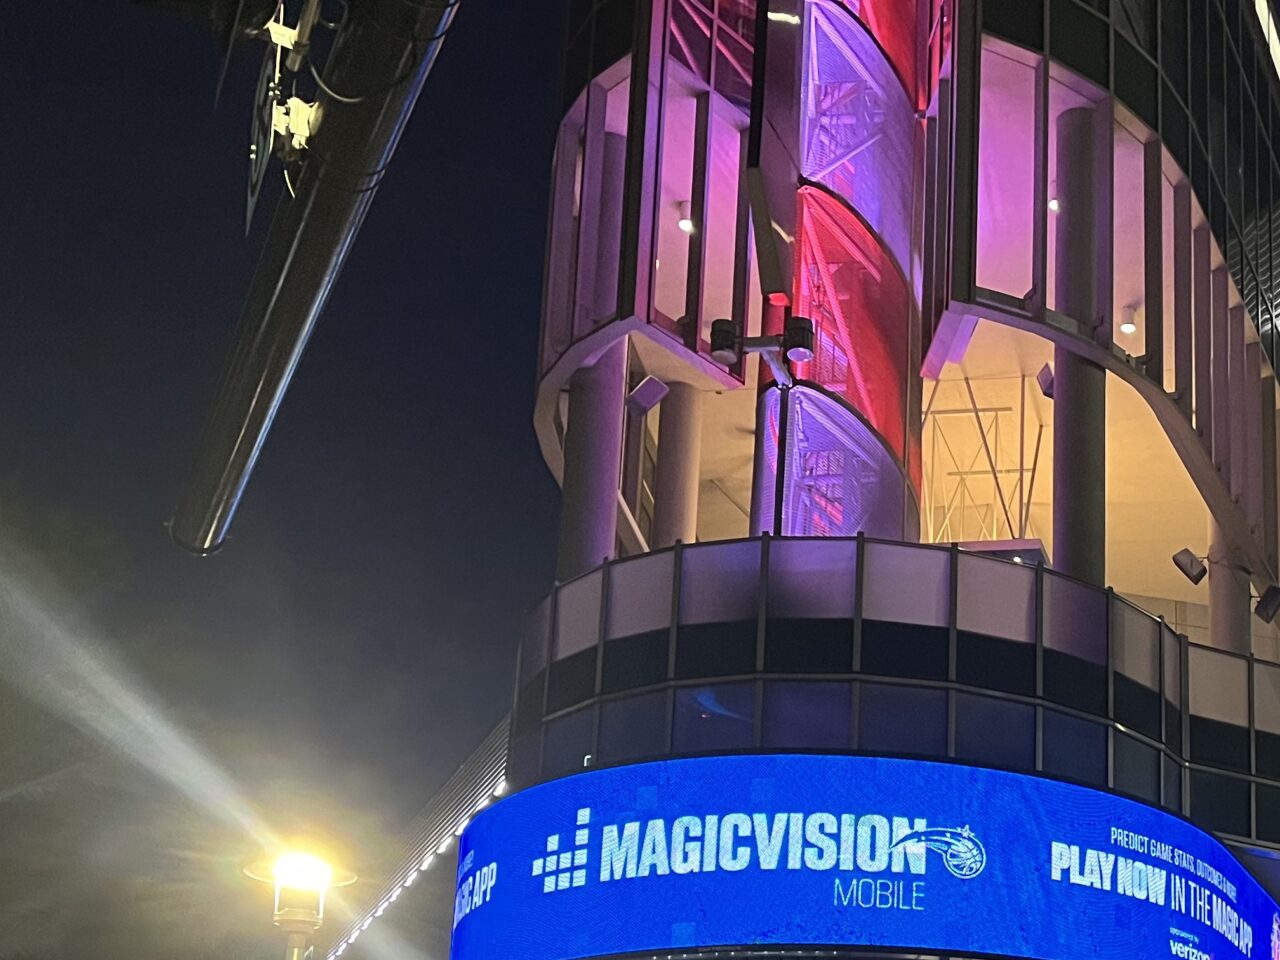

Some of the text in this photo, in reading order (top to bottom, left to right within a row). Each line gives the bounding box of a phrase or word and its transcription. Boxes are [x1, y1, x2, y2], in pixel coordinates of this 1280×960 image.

[600, 812, 926, 881] MAGICVISION
[1111, 826, 1148, 854] PREDICT
[1150, 839, 1173, 864] GAME
[1174, 848, 1196, 875] STATS,
[472, 862, 497, 910] APP
[834, 878, 925, 911] MOBILE
[1051, 841, 1252, 959] PLAY NOW IN THE MAGIC APP
